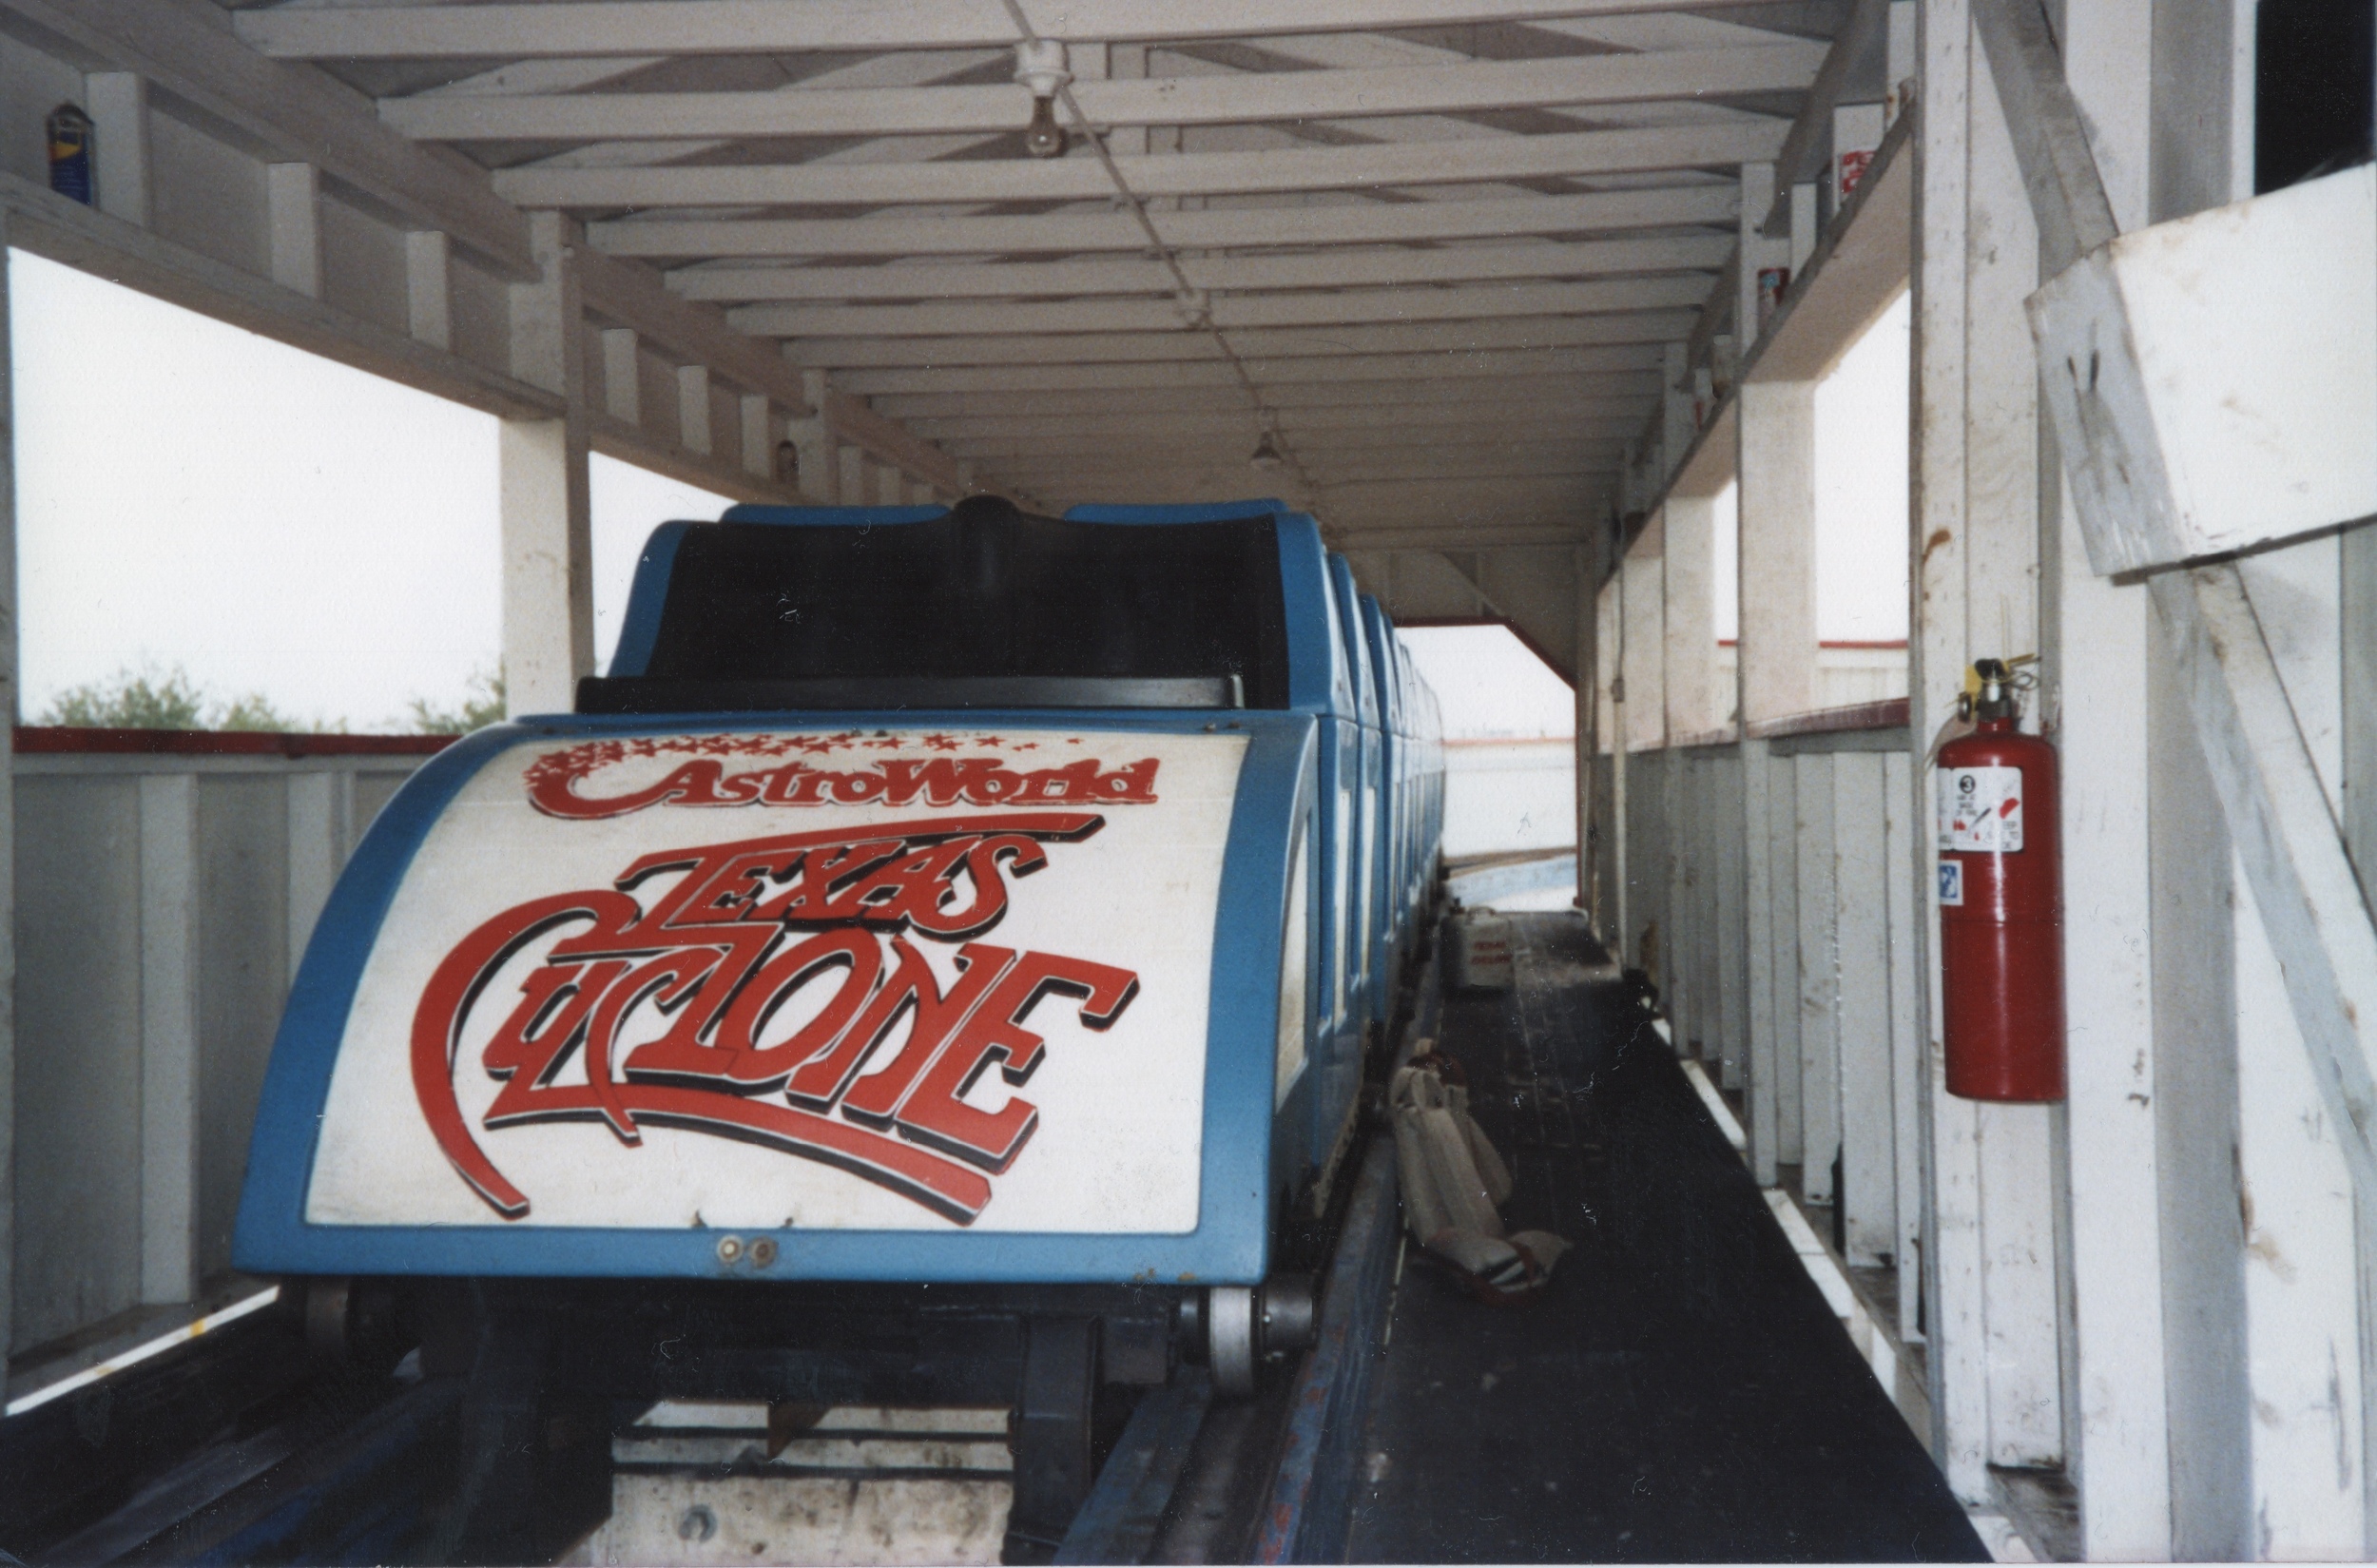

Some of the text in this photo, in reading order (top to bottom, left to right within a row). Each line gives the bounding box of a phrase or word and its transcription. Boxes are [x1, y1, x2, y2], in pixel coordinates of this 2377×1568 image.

[526, 751, 1160, 820] AstroWorld
[614, 813, 1106, 943] TEXAS
[411, 890, 1140, 1226] CYCLONE
